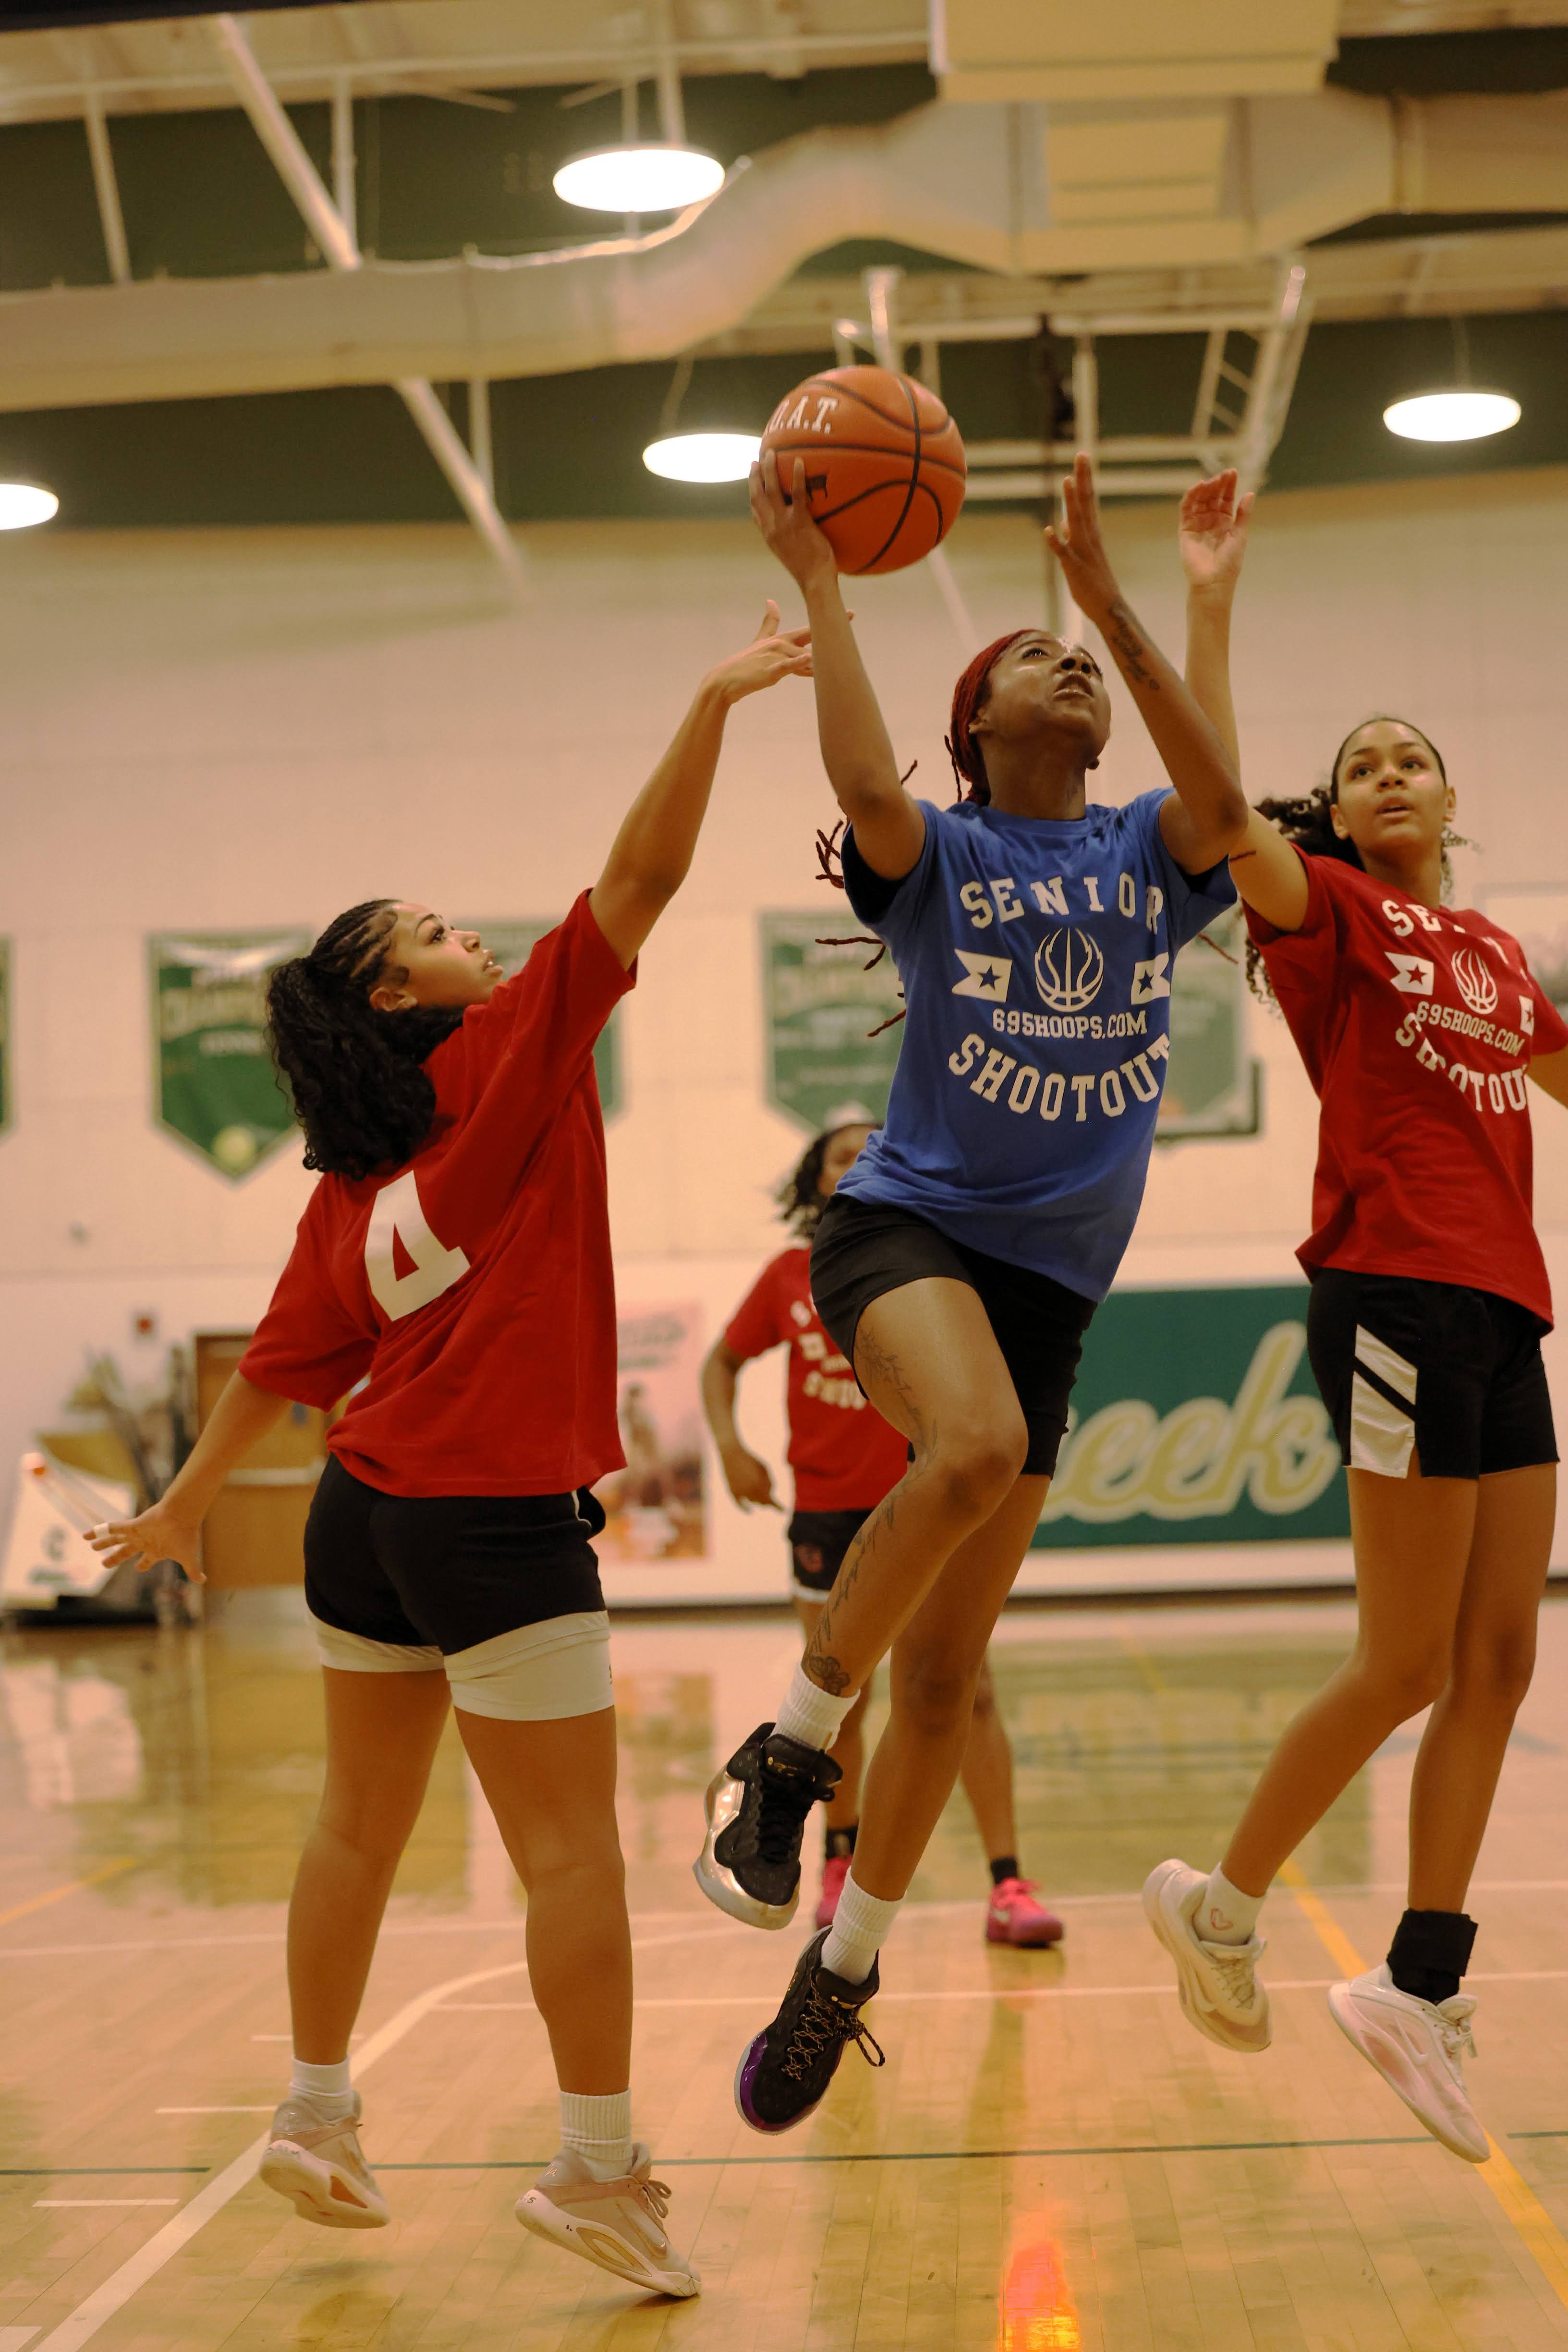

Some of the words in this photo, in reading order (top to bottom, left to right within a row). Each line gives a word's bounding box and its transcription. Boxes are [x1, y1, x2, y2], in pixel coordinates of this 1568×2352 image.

[960, 872, 1164, 934] SENIOR
[992, 1008, 1147, 1040] 695HOOPS.COM
[1417, 1001, 1525, 1057] 695HOOPS.COM
[948, 1033, 1170, 1122] SHOOTOUT
[364, 1169, 471, 1322] 4
